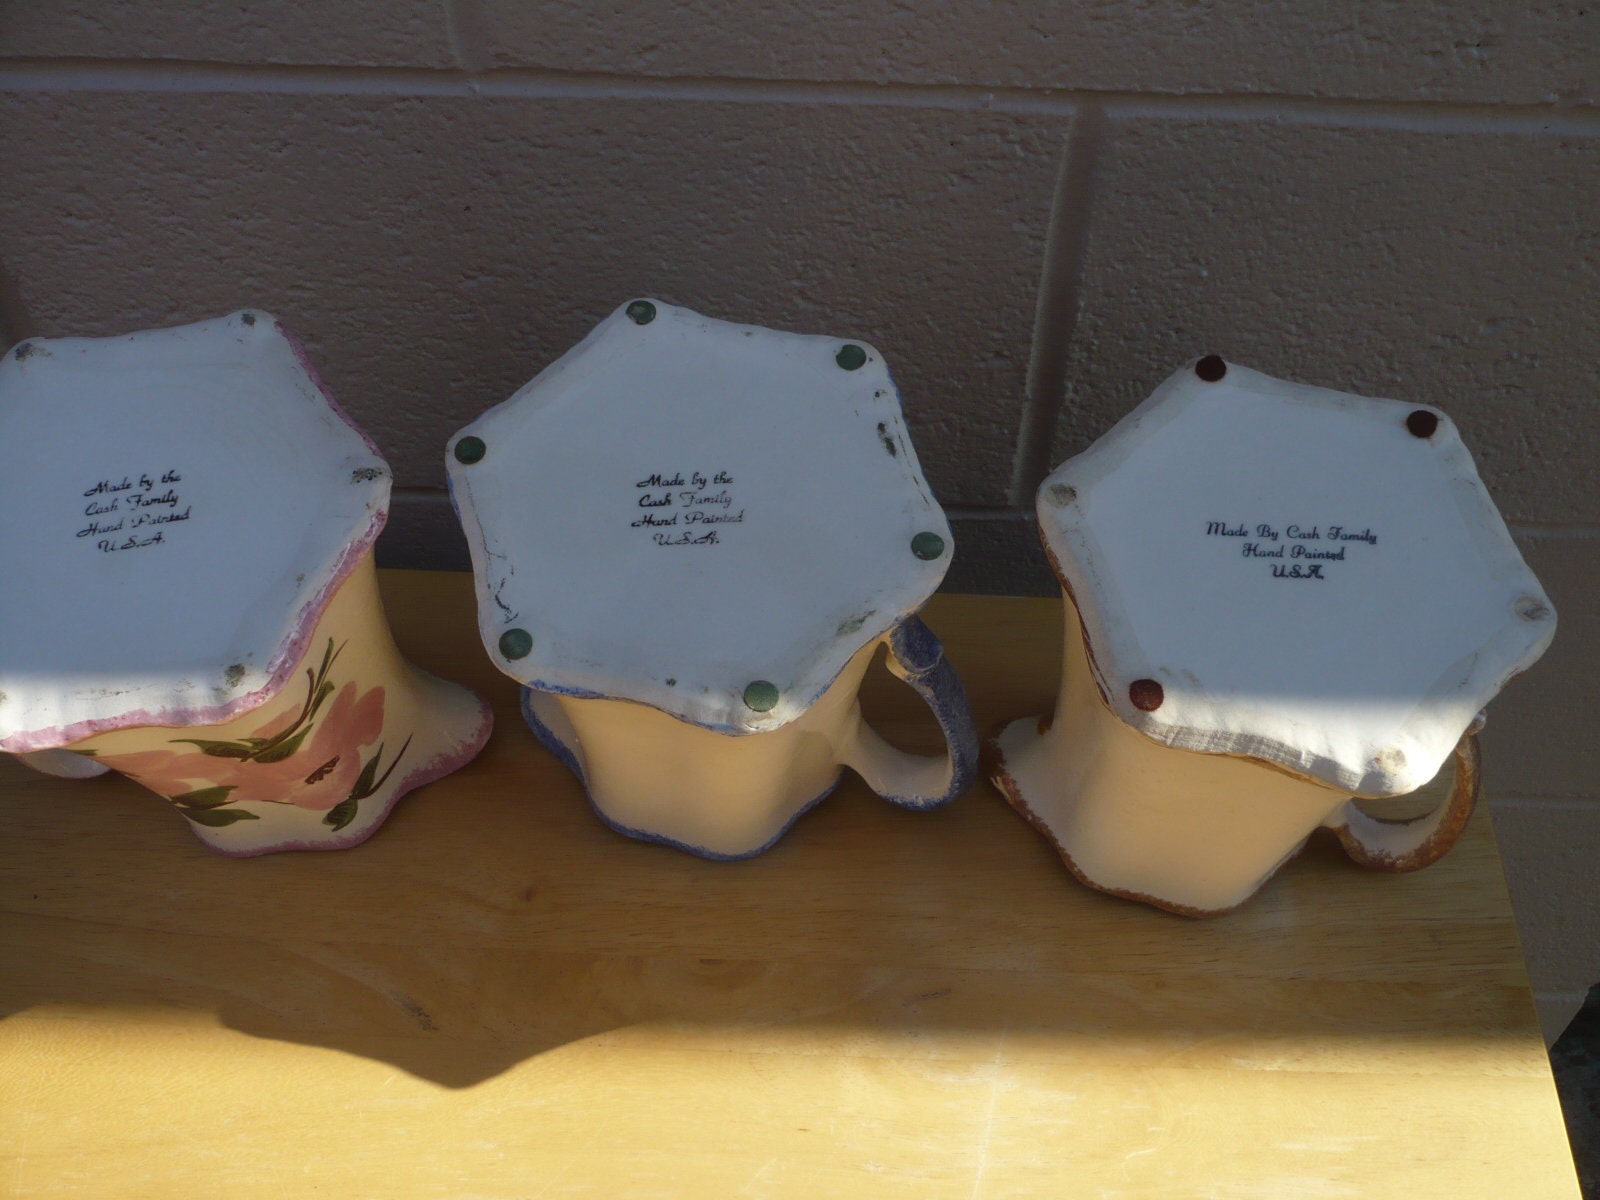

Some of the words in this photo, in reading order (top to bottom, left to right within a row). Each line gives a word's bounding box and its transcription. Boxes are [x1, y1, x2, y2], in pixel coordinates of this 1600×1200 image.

[83, 477, 132, 496] Made
[139, 474, 154, 491] by
[161, 469, 181, 483] the
[636, 472, 685, 488] Made
[691, 472, 707, 490] by
[713, 471, 733, 484] the
[85, 498, 119, 516] Cash
[126, 489, 178, 511] Family
[638, 493, 672, 507] Cash
[679, 490, 732, 509] Family
[76, 517, 124, 538] Hand
[131, 505, 191, 528] Painted
[630, 512, 678, 528] Hand
[685, 508, 745, 525] Painted
[1207, 521, 1248, 537] Made
[1256, 524, 1279, 541] By
[1286, 526, 1320, 540] Cash
[1327, 526, 1377, 545] Family
[1242, 542, 1284, 558] Hand
[1290, 545, 1345, 561] Painted
